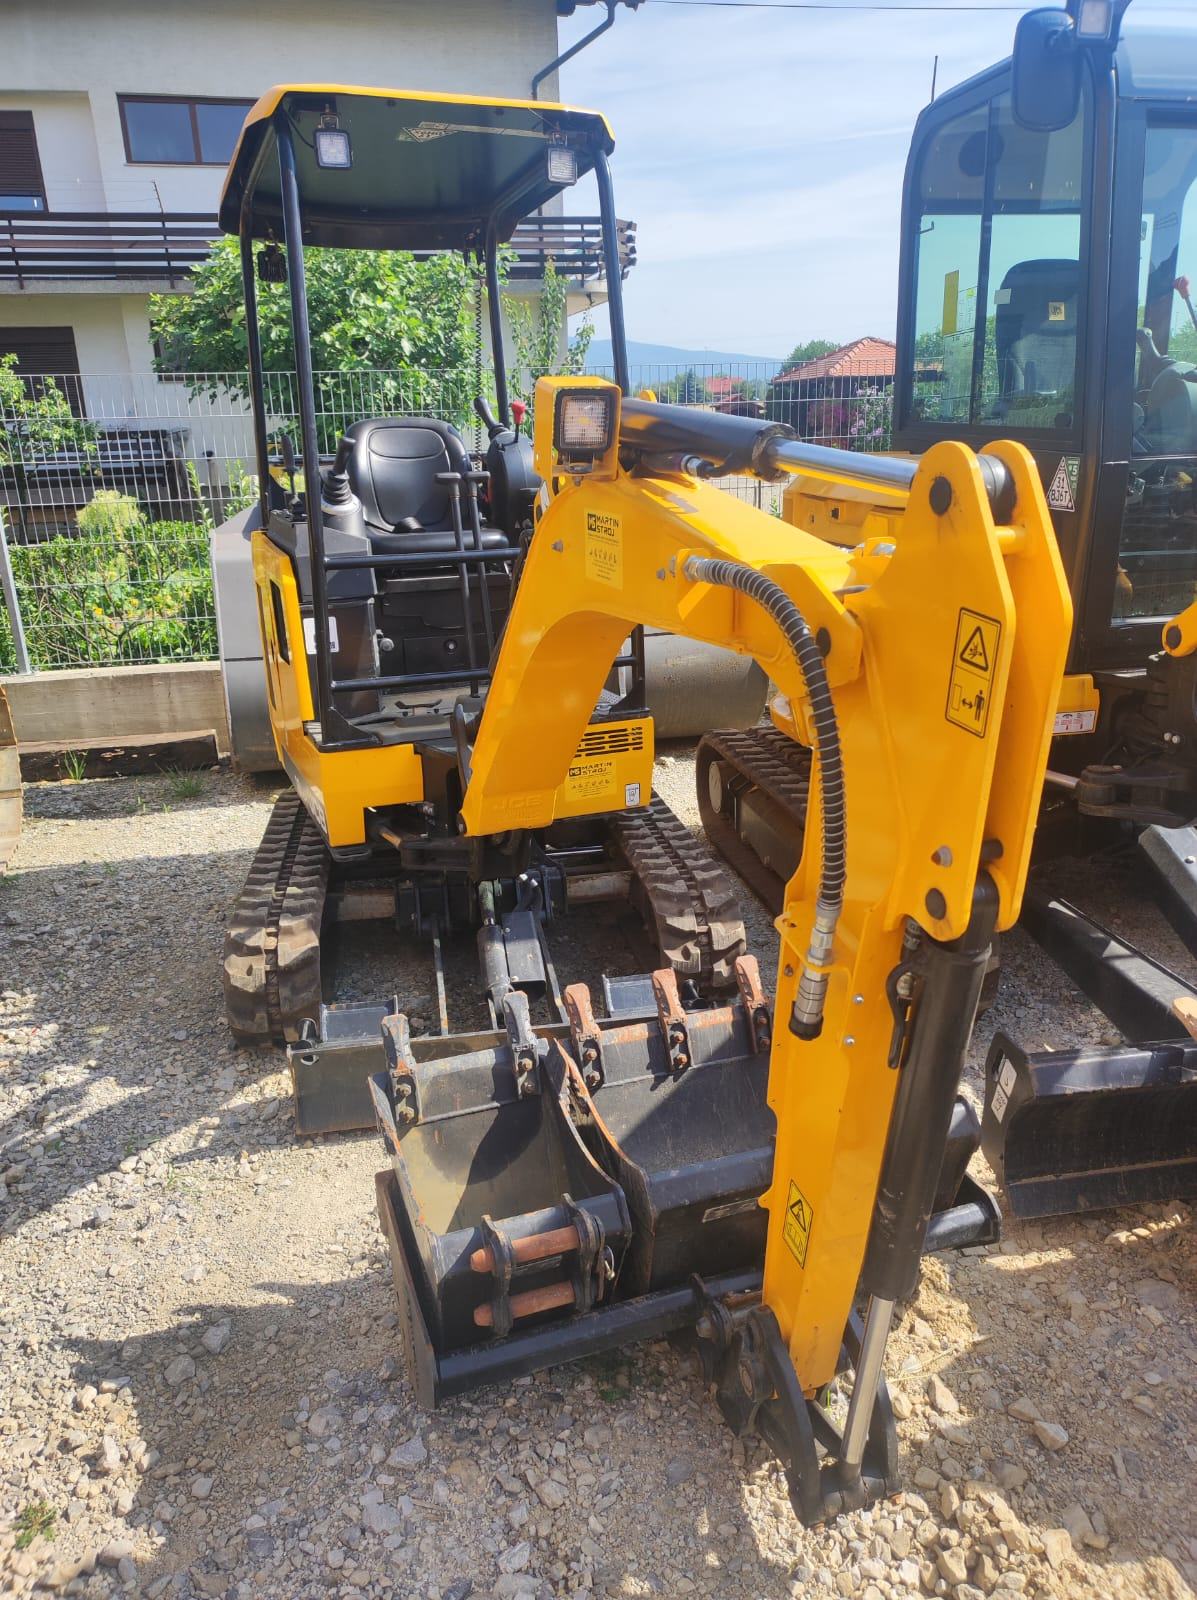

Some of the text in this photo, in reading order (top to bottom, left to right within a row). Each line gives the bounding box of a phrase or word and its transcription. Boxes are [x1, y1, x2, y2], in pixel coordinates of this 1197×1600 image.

[597, 515, 619, 528] MARTIN
[596, 525, 615, 537] STROJ
[582, 762, 612, 771] MARTIN
